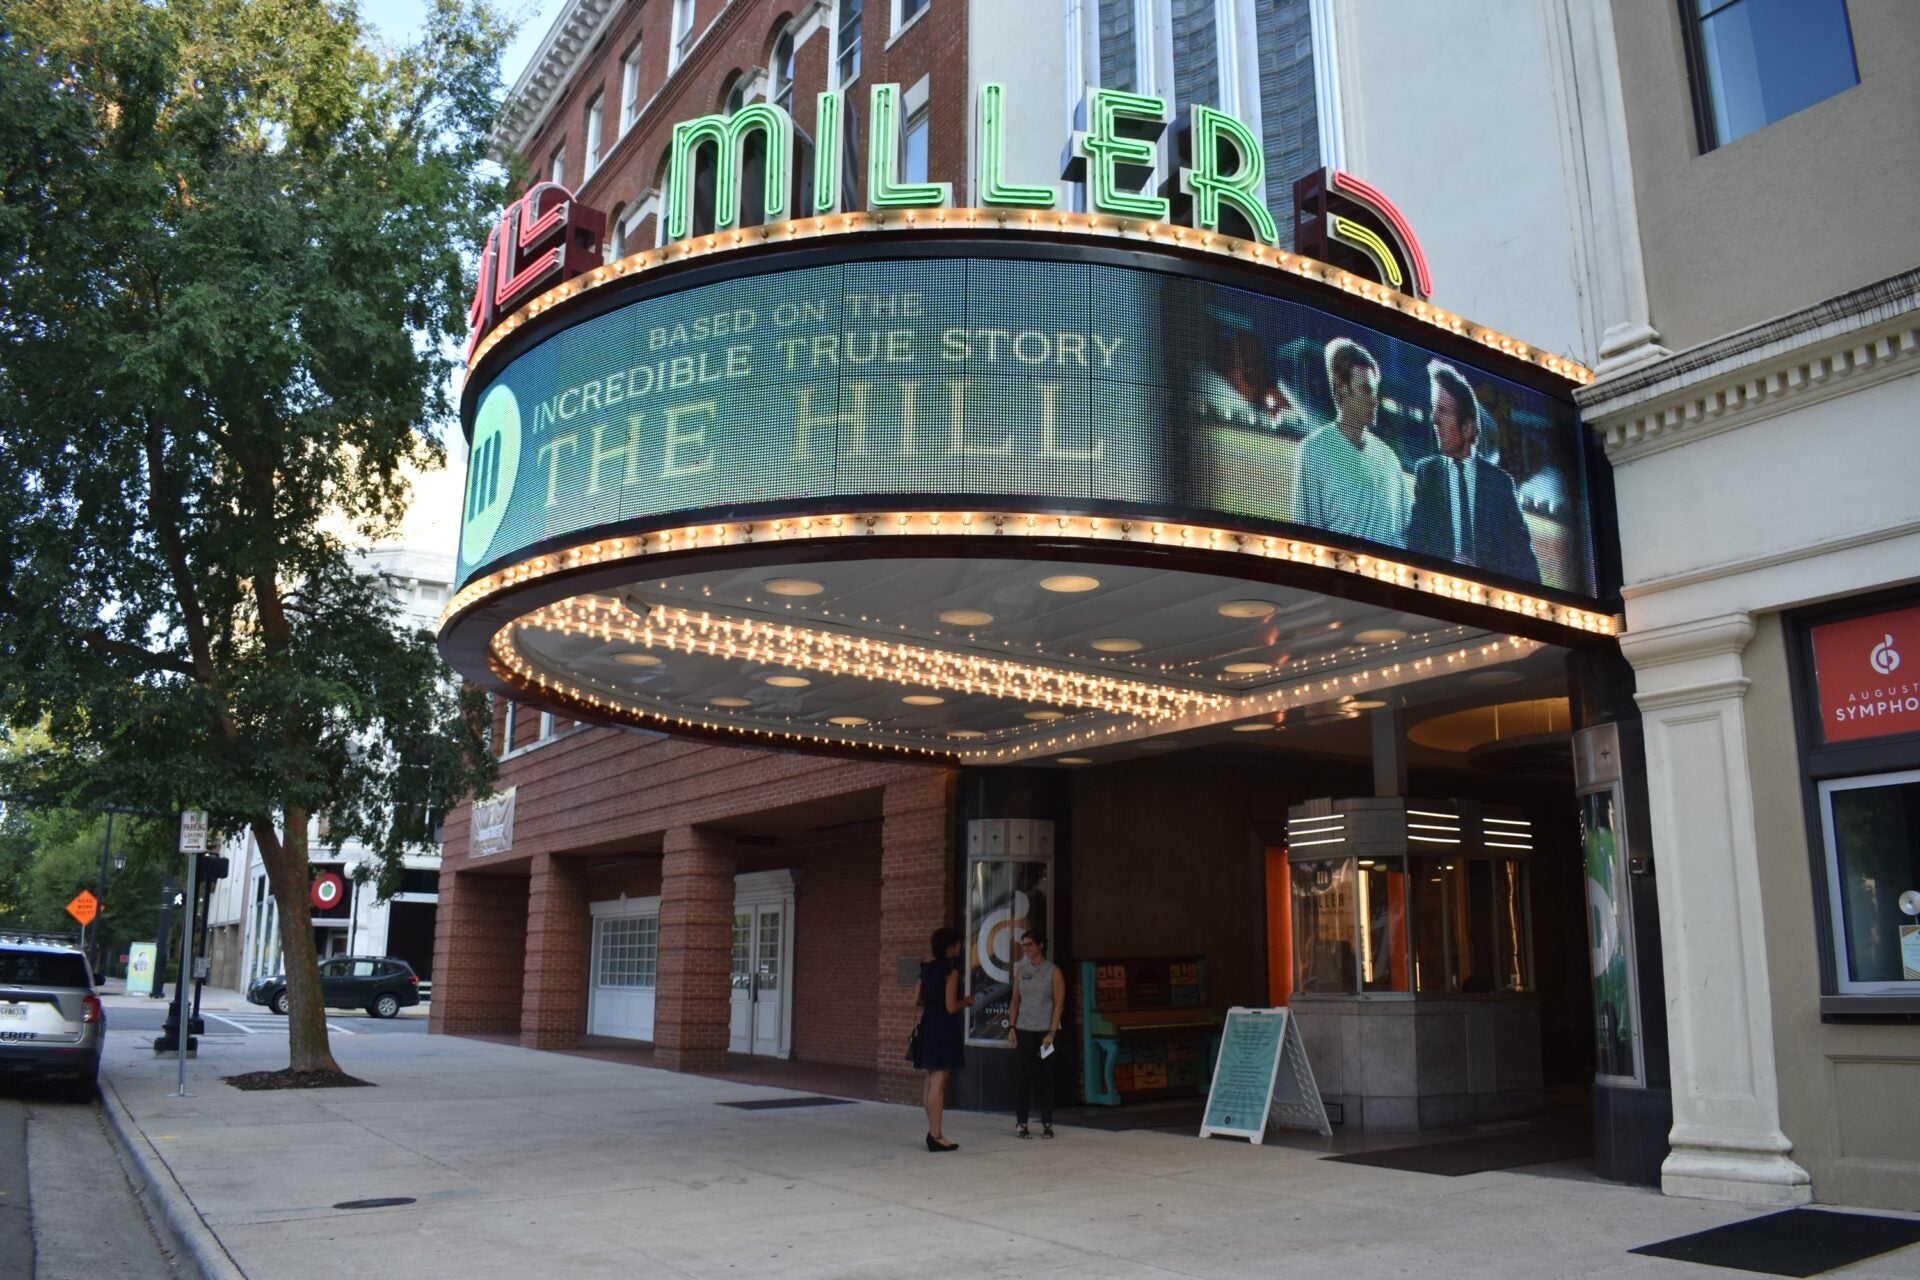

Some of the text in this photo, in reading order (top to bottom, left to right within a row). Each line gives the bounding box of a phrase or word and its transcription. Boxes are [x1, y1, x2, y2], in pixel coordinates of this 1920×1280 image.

[668, 81, 1279, 243] MILLER
[532, 327, 1121, 434] INCREDIBLE TRUE STORY
[649, 293, 923, 351] BASED ON THE
[535, 377, 1103, 511] THE HILL
